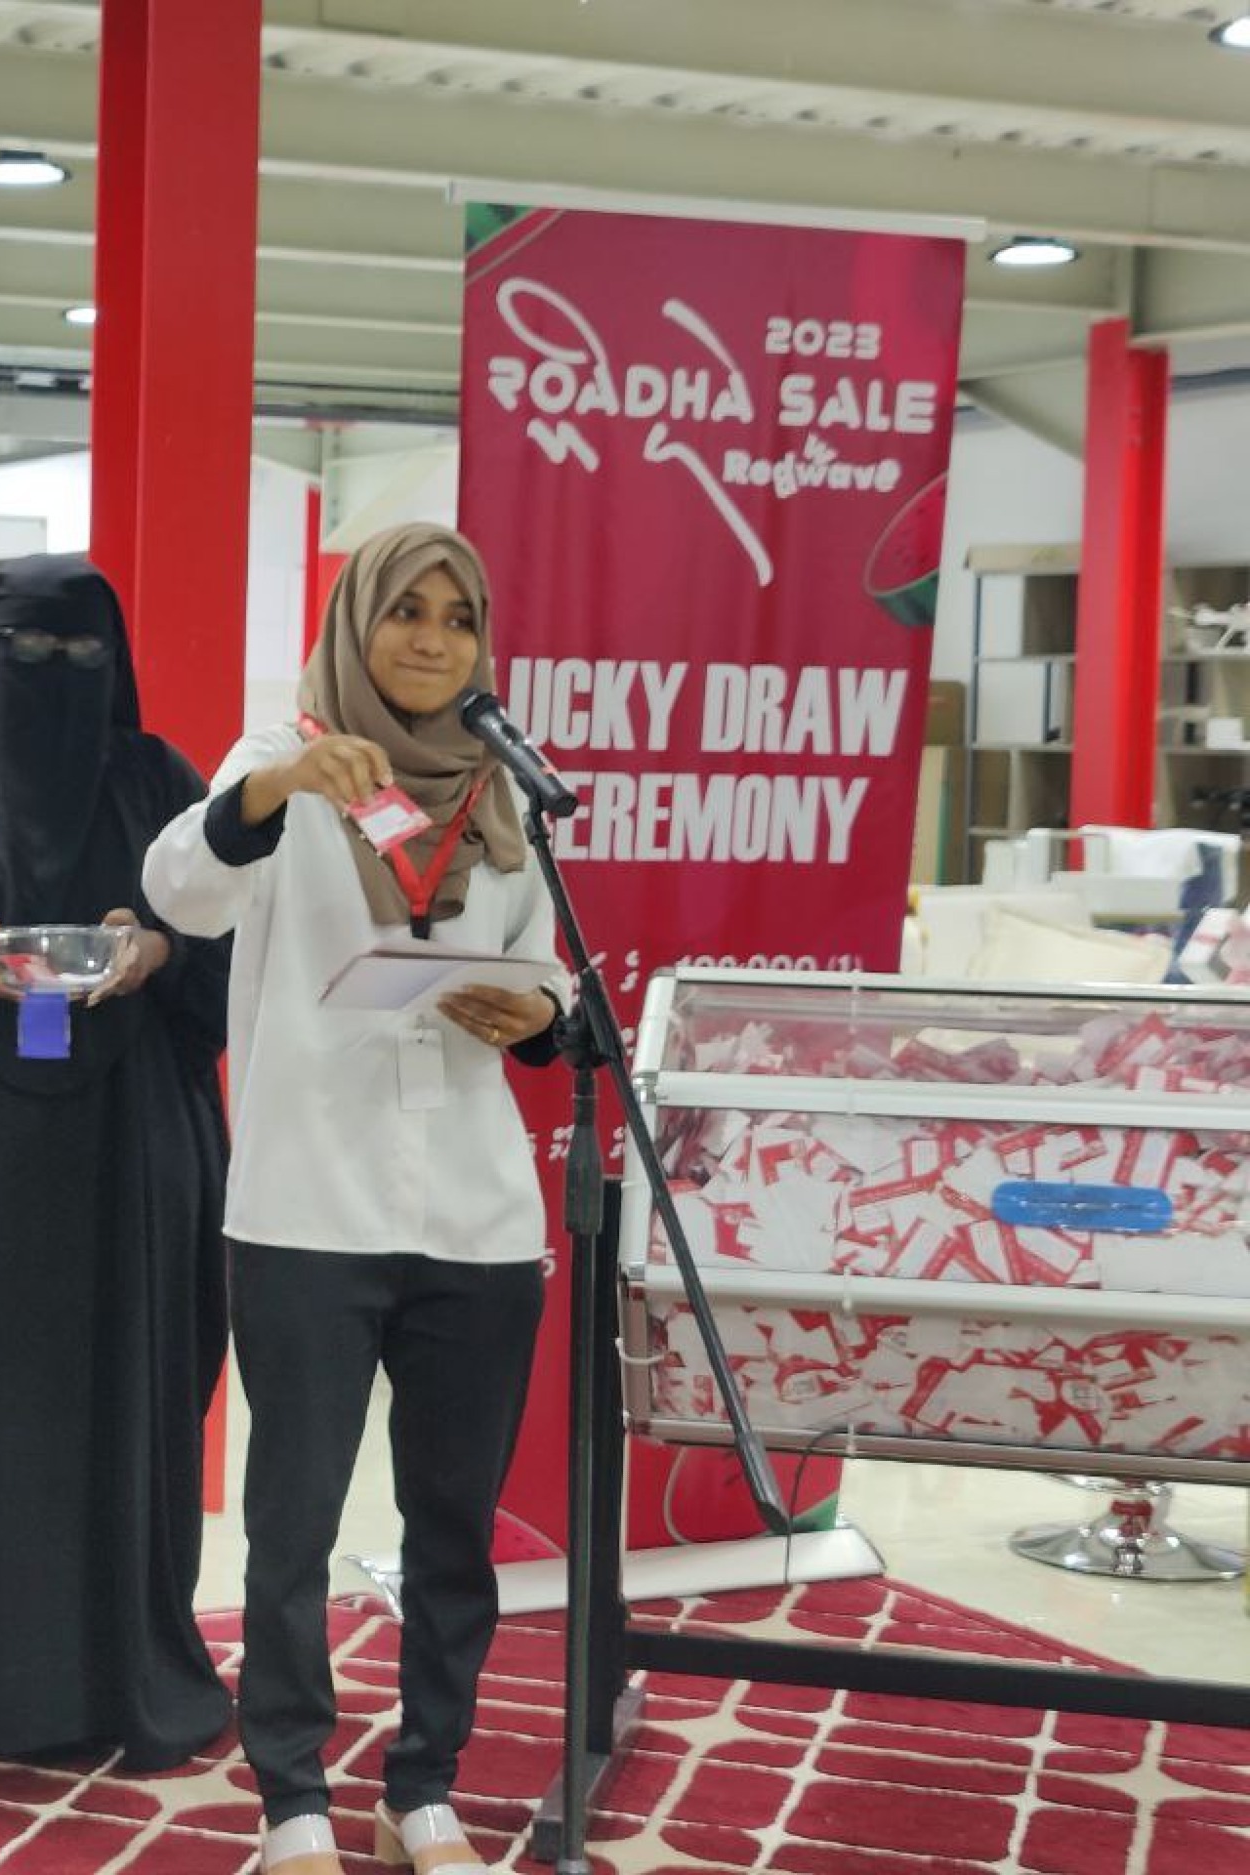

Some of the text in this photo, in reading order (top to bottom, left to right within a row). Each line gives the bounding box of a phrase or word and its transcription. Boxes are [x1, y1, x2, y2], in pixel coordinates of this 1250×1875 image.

[765, 316, 881, 360] 2023
[488, 356, 937, 434] ROADHA SALE
[723, 449, 902, 499] Redwave
[491, 656, 908, 757] UCKY DRAW
[546, 770, 872, 864] EREMONY
